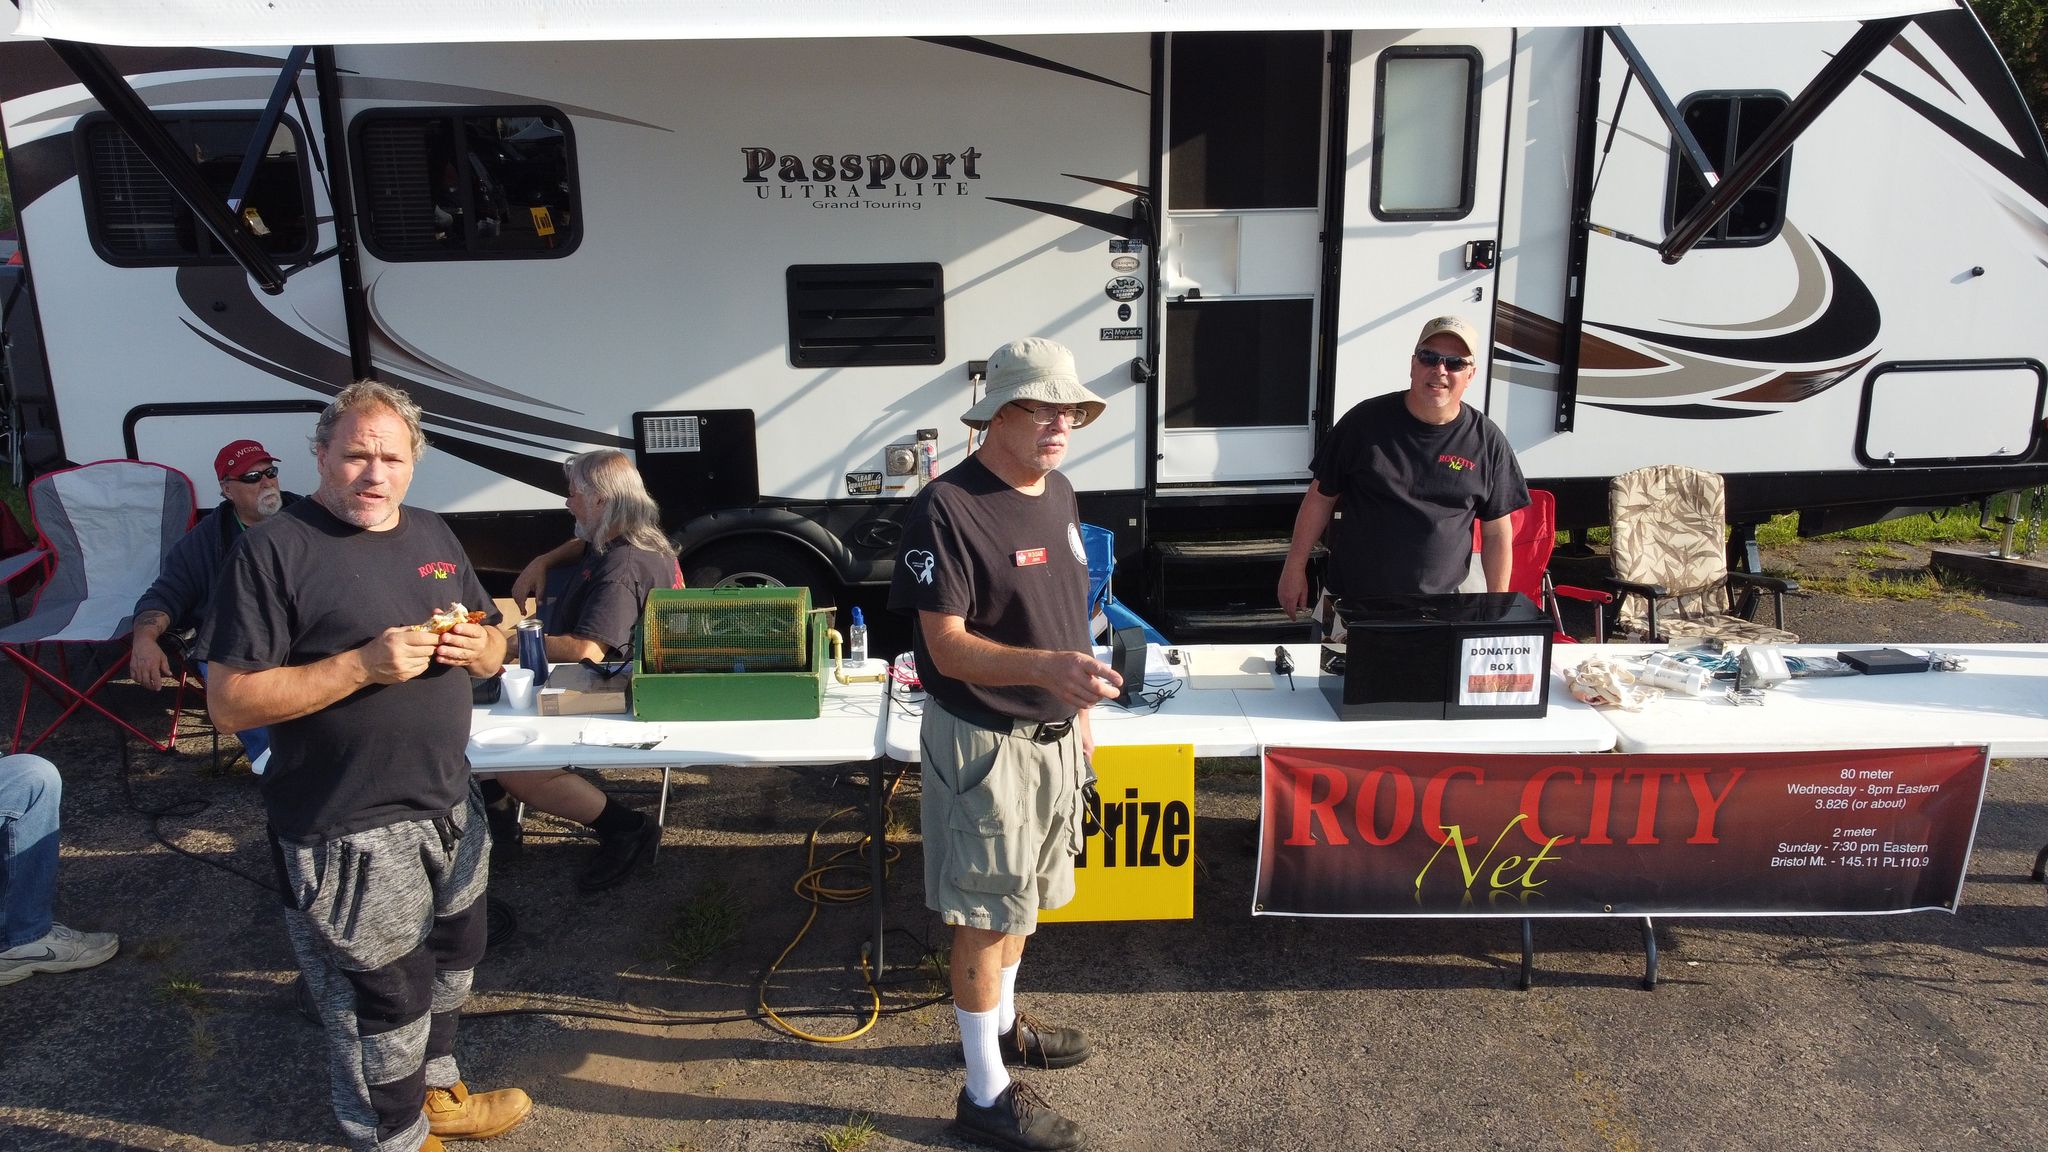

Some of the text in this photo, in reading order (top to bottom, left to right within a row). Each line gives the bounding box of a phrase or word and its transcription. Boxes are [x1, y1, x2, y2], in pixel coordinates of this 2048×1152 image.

[740, 146, 983, 189] Passport
[755, 182, 969, 199] ULTRA LITE
[812, 200, 922, 211] Grand Touring
[1114, 328, 1142, 337] Meyer's
[1439, 454, 1457, 463] ROC
[417, 561, 457, 578] ROC CITY
[434, 568, 448, 579] Net
[1470, 647, 1531, 656] DONATION
[1490, 663, 1514, 671] BOX
[1840, 769, 1894, 780] 80 meter
[1787, 783, 1857, 796] Wednesday
[1867, 784, 1893, 796] 8pm
[1896, 783, 1940, 794] Eastern
[1284, 765, 1747, 847] ROC CITY
[1815, 798, 1907, 811] 3.826 (or about)
[1075, 788, 1190, 868] Prize
[1832, 827, 1877, 838] 2 meter
[1414, 813, 1564, 889] Net
[1777, 842, 1822, 855] Sunday
[1832, 841, 1858, 852] 7:30
[1860, 843, 1879, 854] pm
[1883, 842, 1929, 853] Eastern
[1770, 856, 1807, 867] Bristol
[1809, 855, 1827, 867] Mt.
[1840, 856, 1878, 867] 145.11
[1882, 857, 1929, 868] PL110.9
